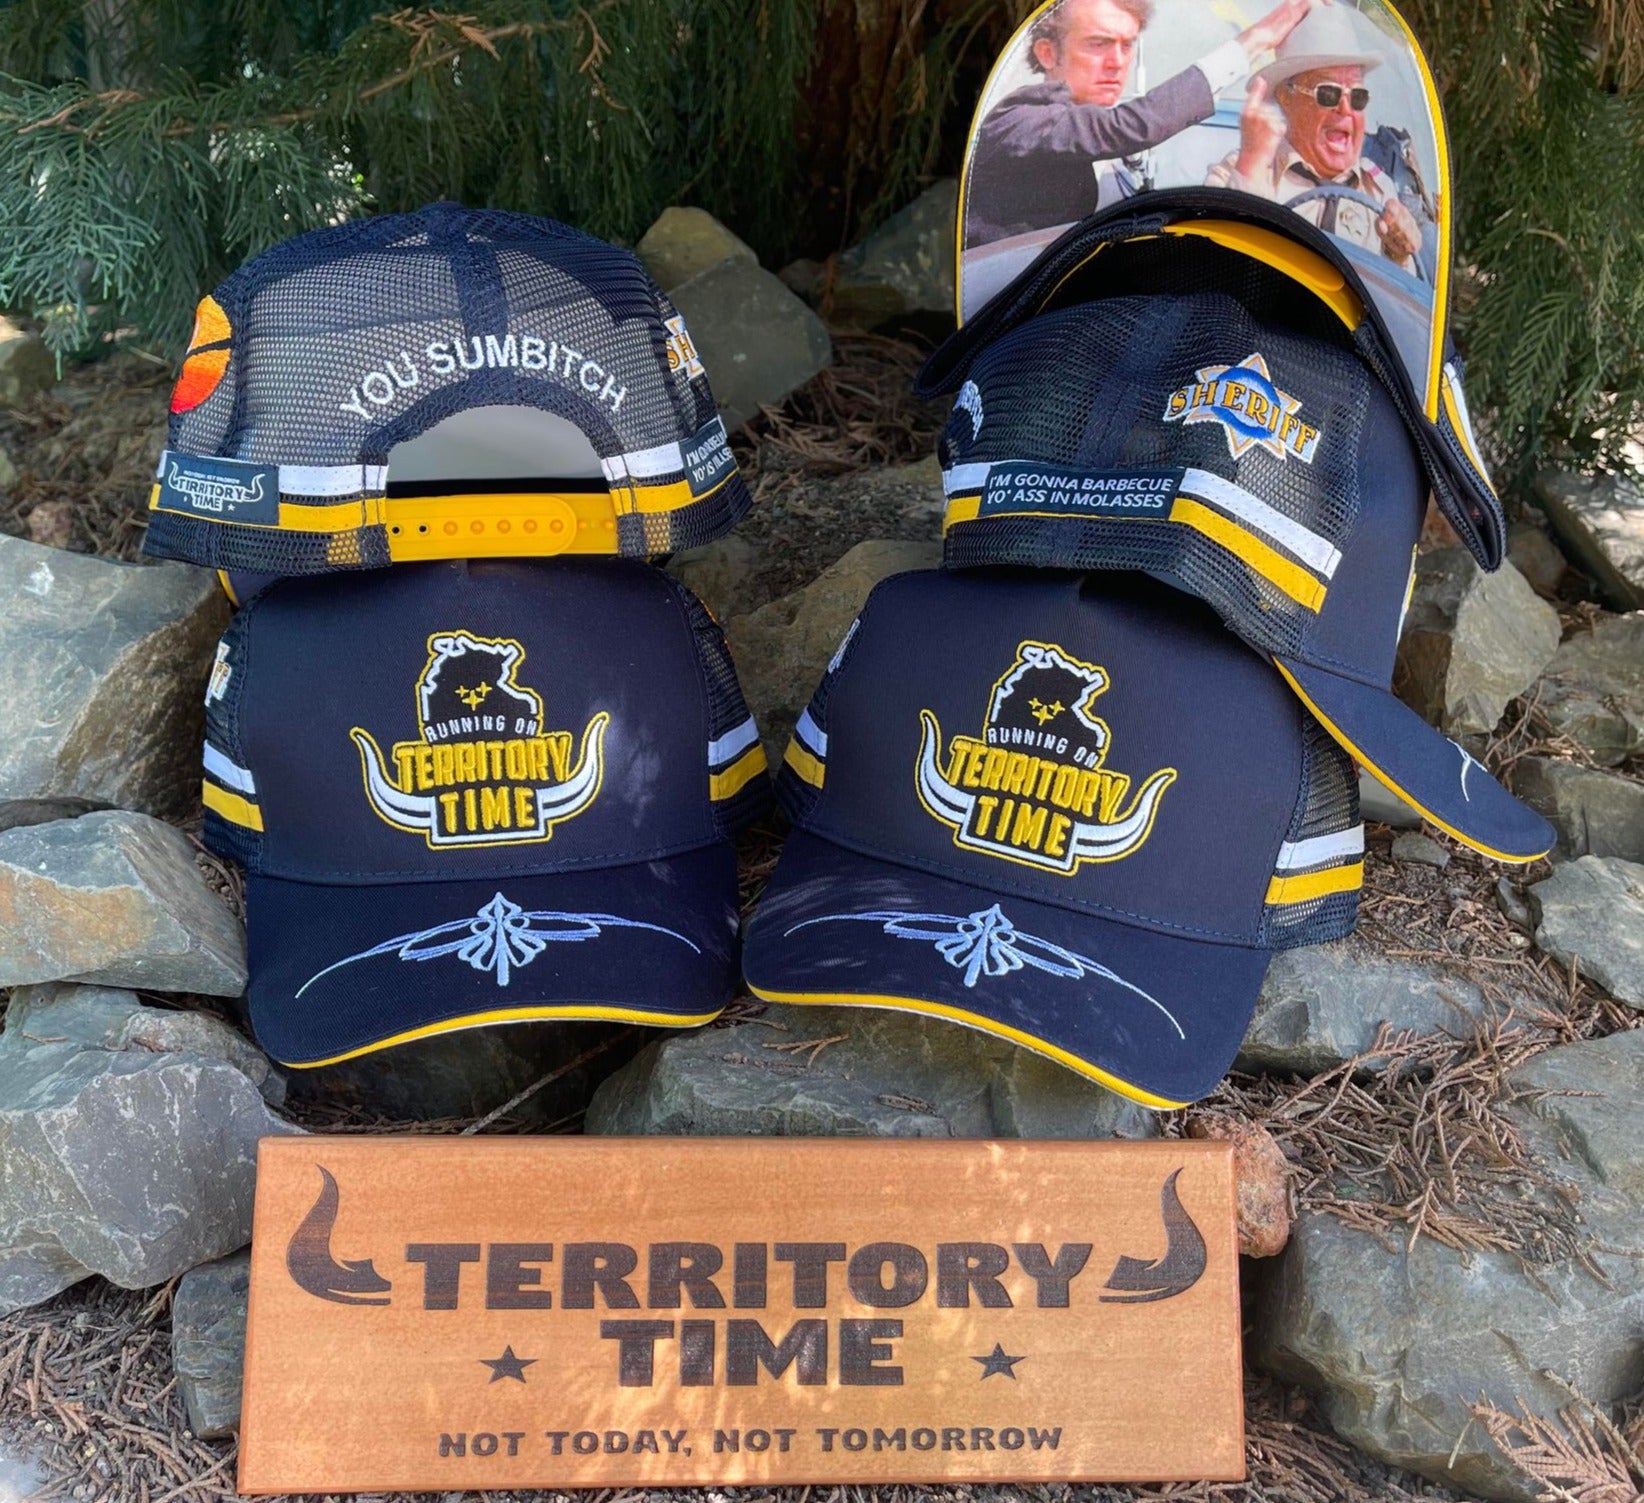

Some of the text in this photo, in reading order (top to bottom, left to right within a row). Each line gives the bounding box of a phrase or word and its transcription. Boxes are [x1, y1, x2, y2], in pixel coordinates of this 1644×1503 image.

[340, 334, 628, 420] YOU SUMBITCH
[1168, 380, 1318, 454] SHERIFF
[193, 493, 221, 510] TIME
[986, 488, 1166, 508] YO' ASS IN MOLASSES
[989, 473, 1174, 492] I'M GONNA BARBECUE
[423, 715, 538, 743] RUNNING ON
[987, 727, 1100, 769] RUNNING ON
[396, 736, 570, 794] TERRITORY
[950, 740, 1127, 823] TERRITORY
[439, 786, 536, 834] TIME
[975, 795, 1072, 857] TIME
[405, 1241, 1094, 1310] TERRITORY
[600, 1318, 905, 1388] TIME
[438, 1426, 1063, 1458] NOT TODAY, NOT TOMORROW
